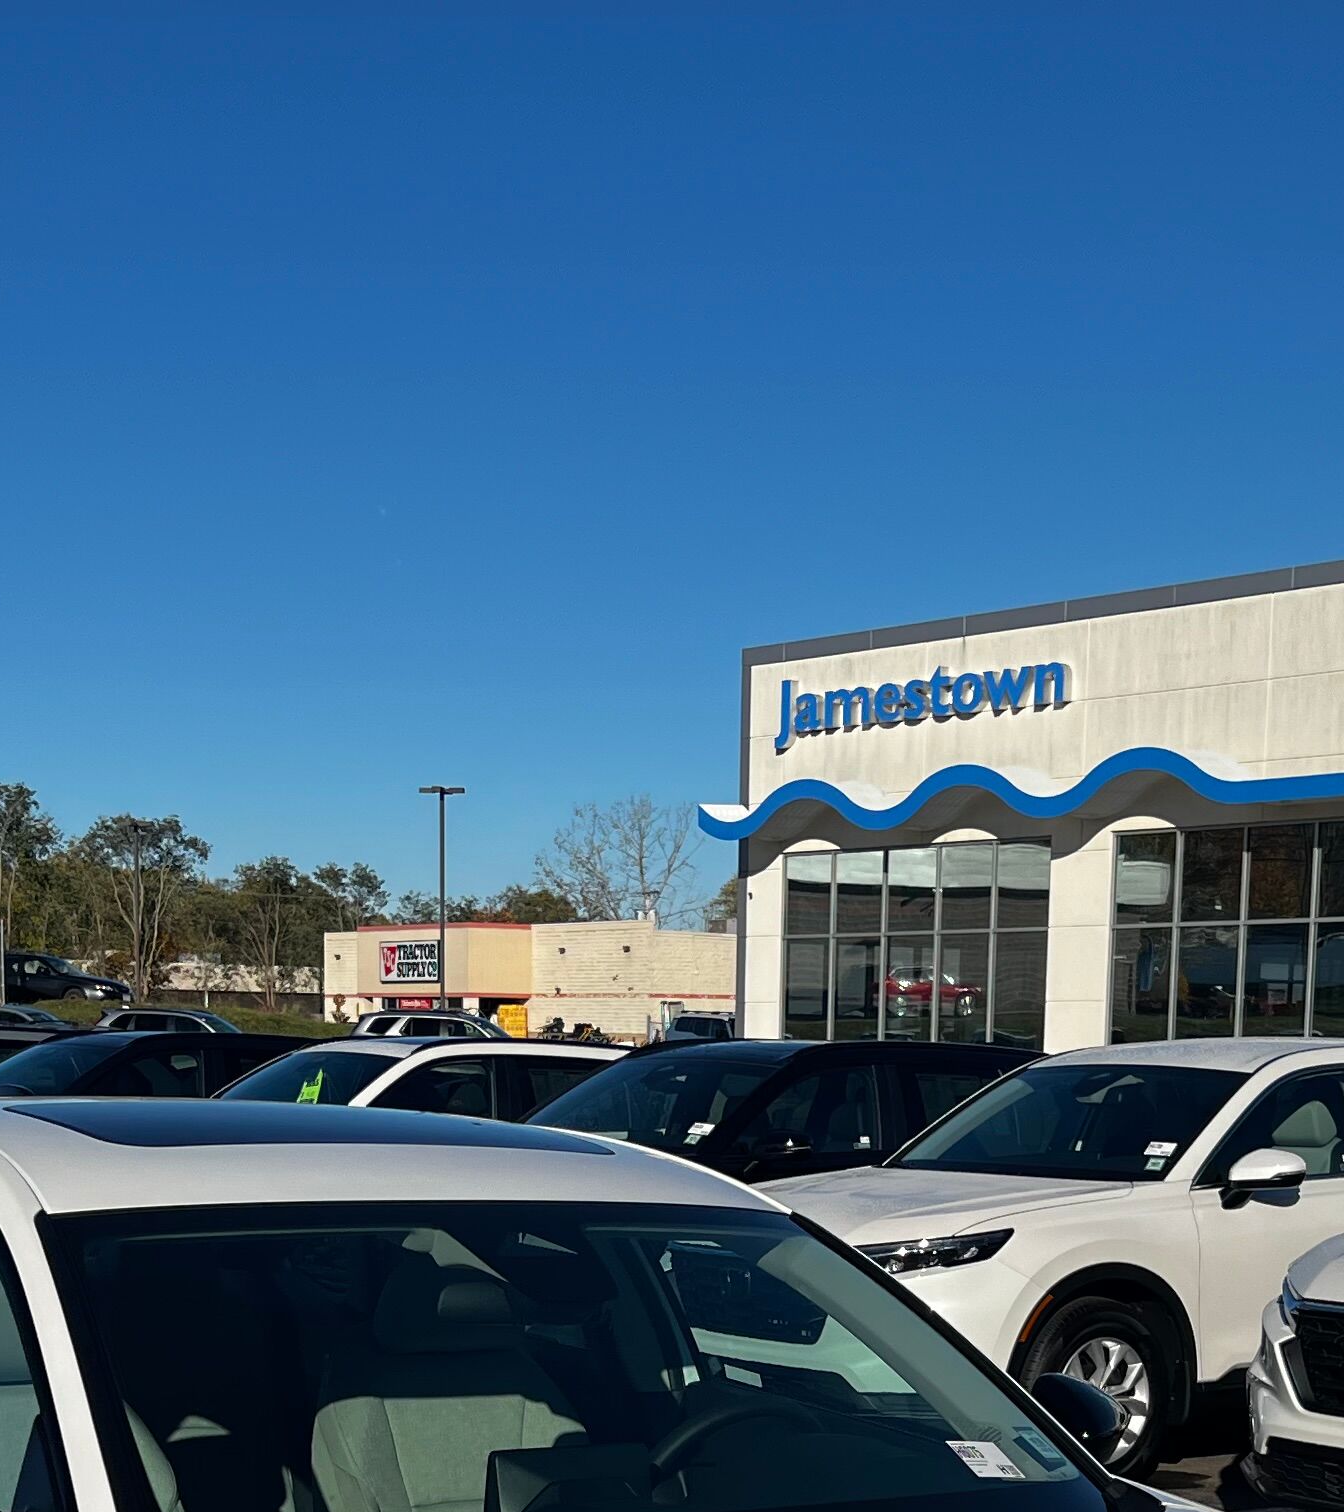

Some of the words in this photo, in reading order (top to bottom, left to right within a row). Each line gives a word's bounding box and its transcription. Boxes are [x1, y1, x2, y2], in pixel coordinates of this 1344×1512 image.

[774, 661, 1072, 752] Jamestown
[396, 943, 436, 960] TRACTOR
[396, 961, 426, 977] SUPPLY
